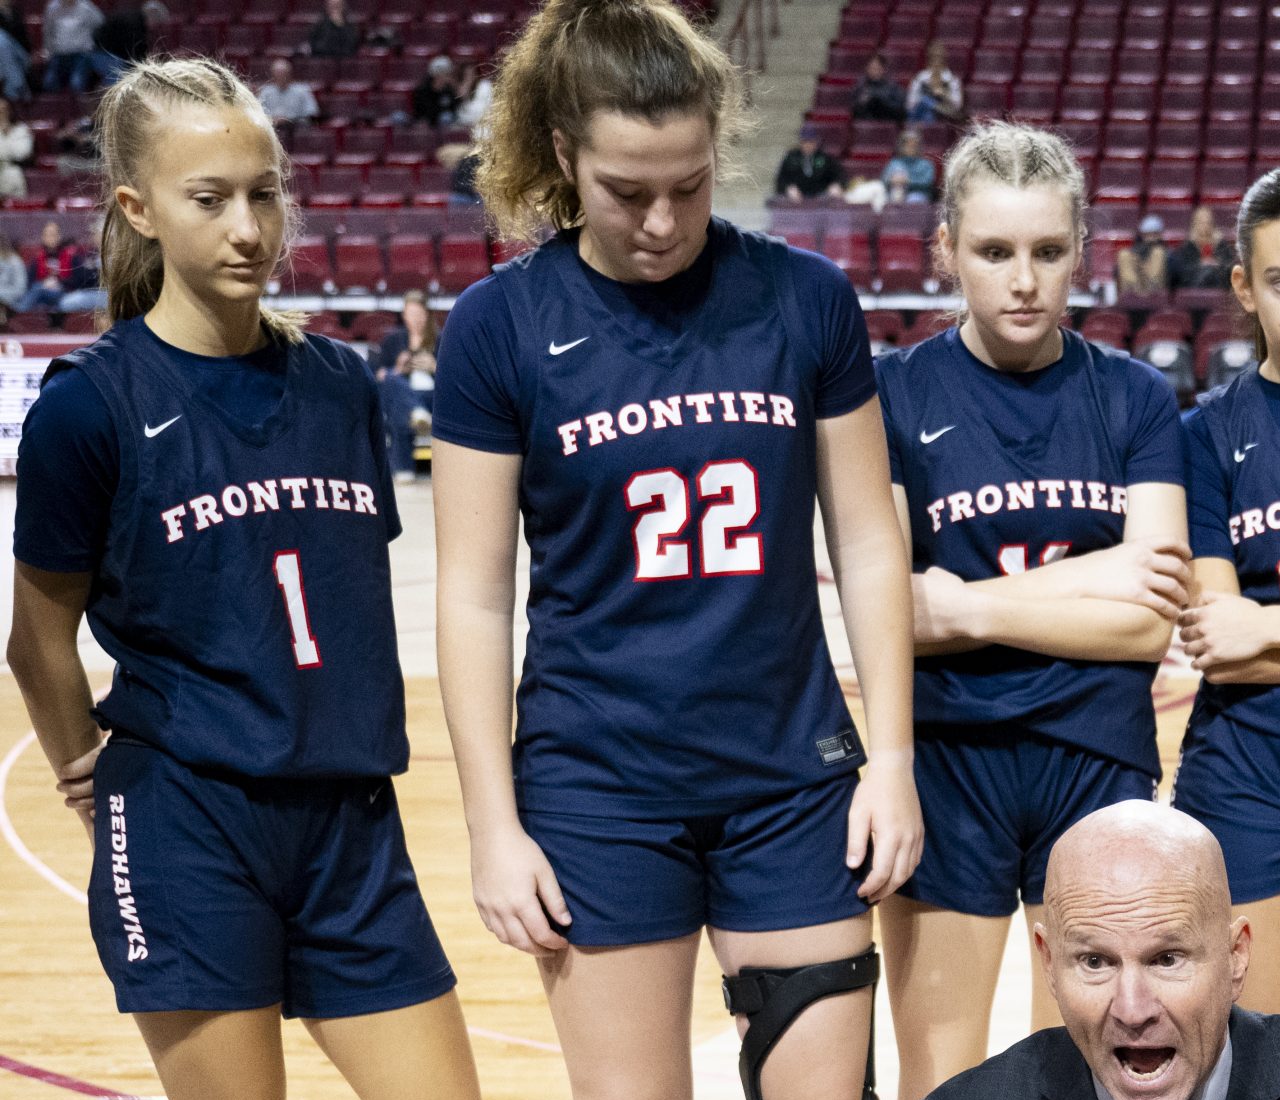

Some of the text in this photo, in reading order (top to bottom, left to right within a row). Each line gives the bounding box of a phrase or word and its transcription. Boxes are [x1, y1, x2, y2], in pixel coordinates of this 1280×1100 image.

[557, 391, 797, 456] FRONTIER
[161, 477, 378, 544] FRONTIER
[623, 458, 765, 582] 22
[926, 479, 1127, 534] FRONTIER
[273, 549, 323, 670] 1
[109, 793, 149, 963] REDHAWKS
